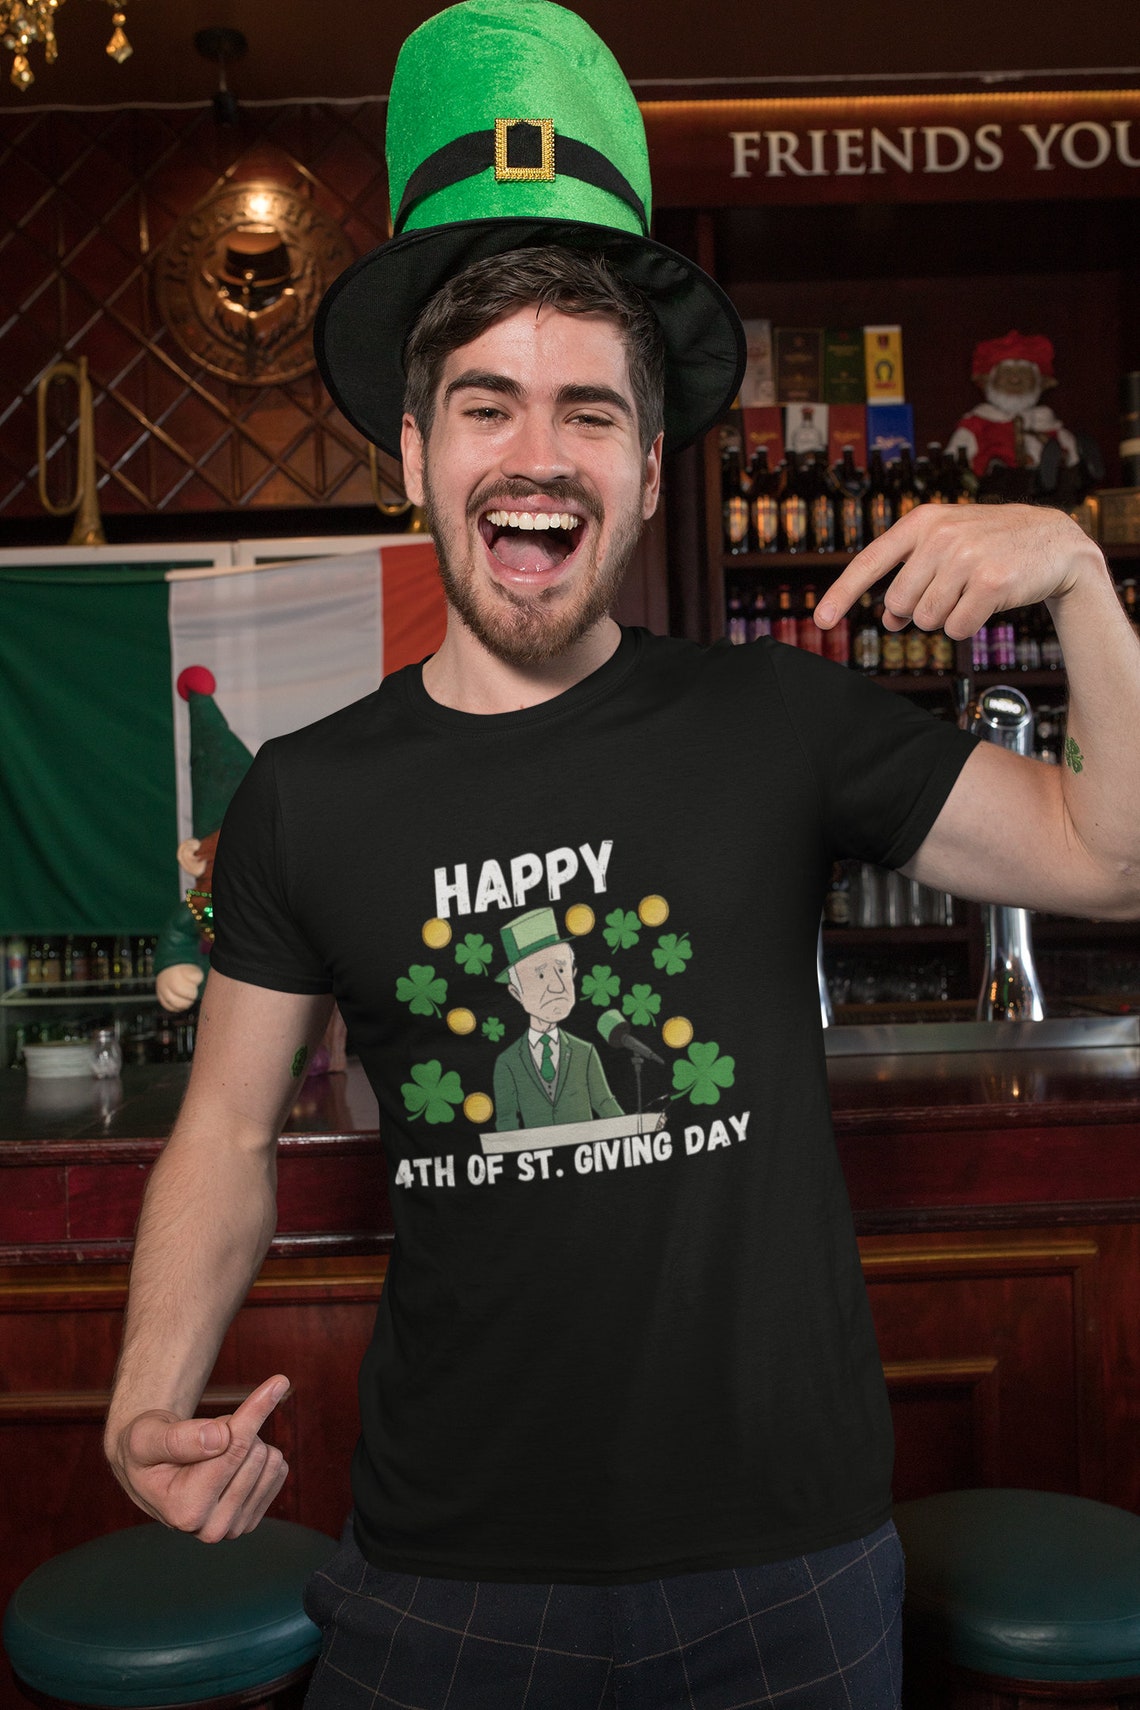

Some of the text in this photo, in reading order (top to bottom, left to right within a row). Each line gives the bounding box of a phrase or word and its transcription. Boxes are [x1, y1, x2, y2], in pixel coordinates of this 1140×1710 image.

[730, 124, 1004, 178] FRIENDS
[433, 839, 614, 920] HAPPY
[394, 1111, 751, 1189] 4TH OF ST. GIVING DAY
